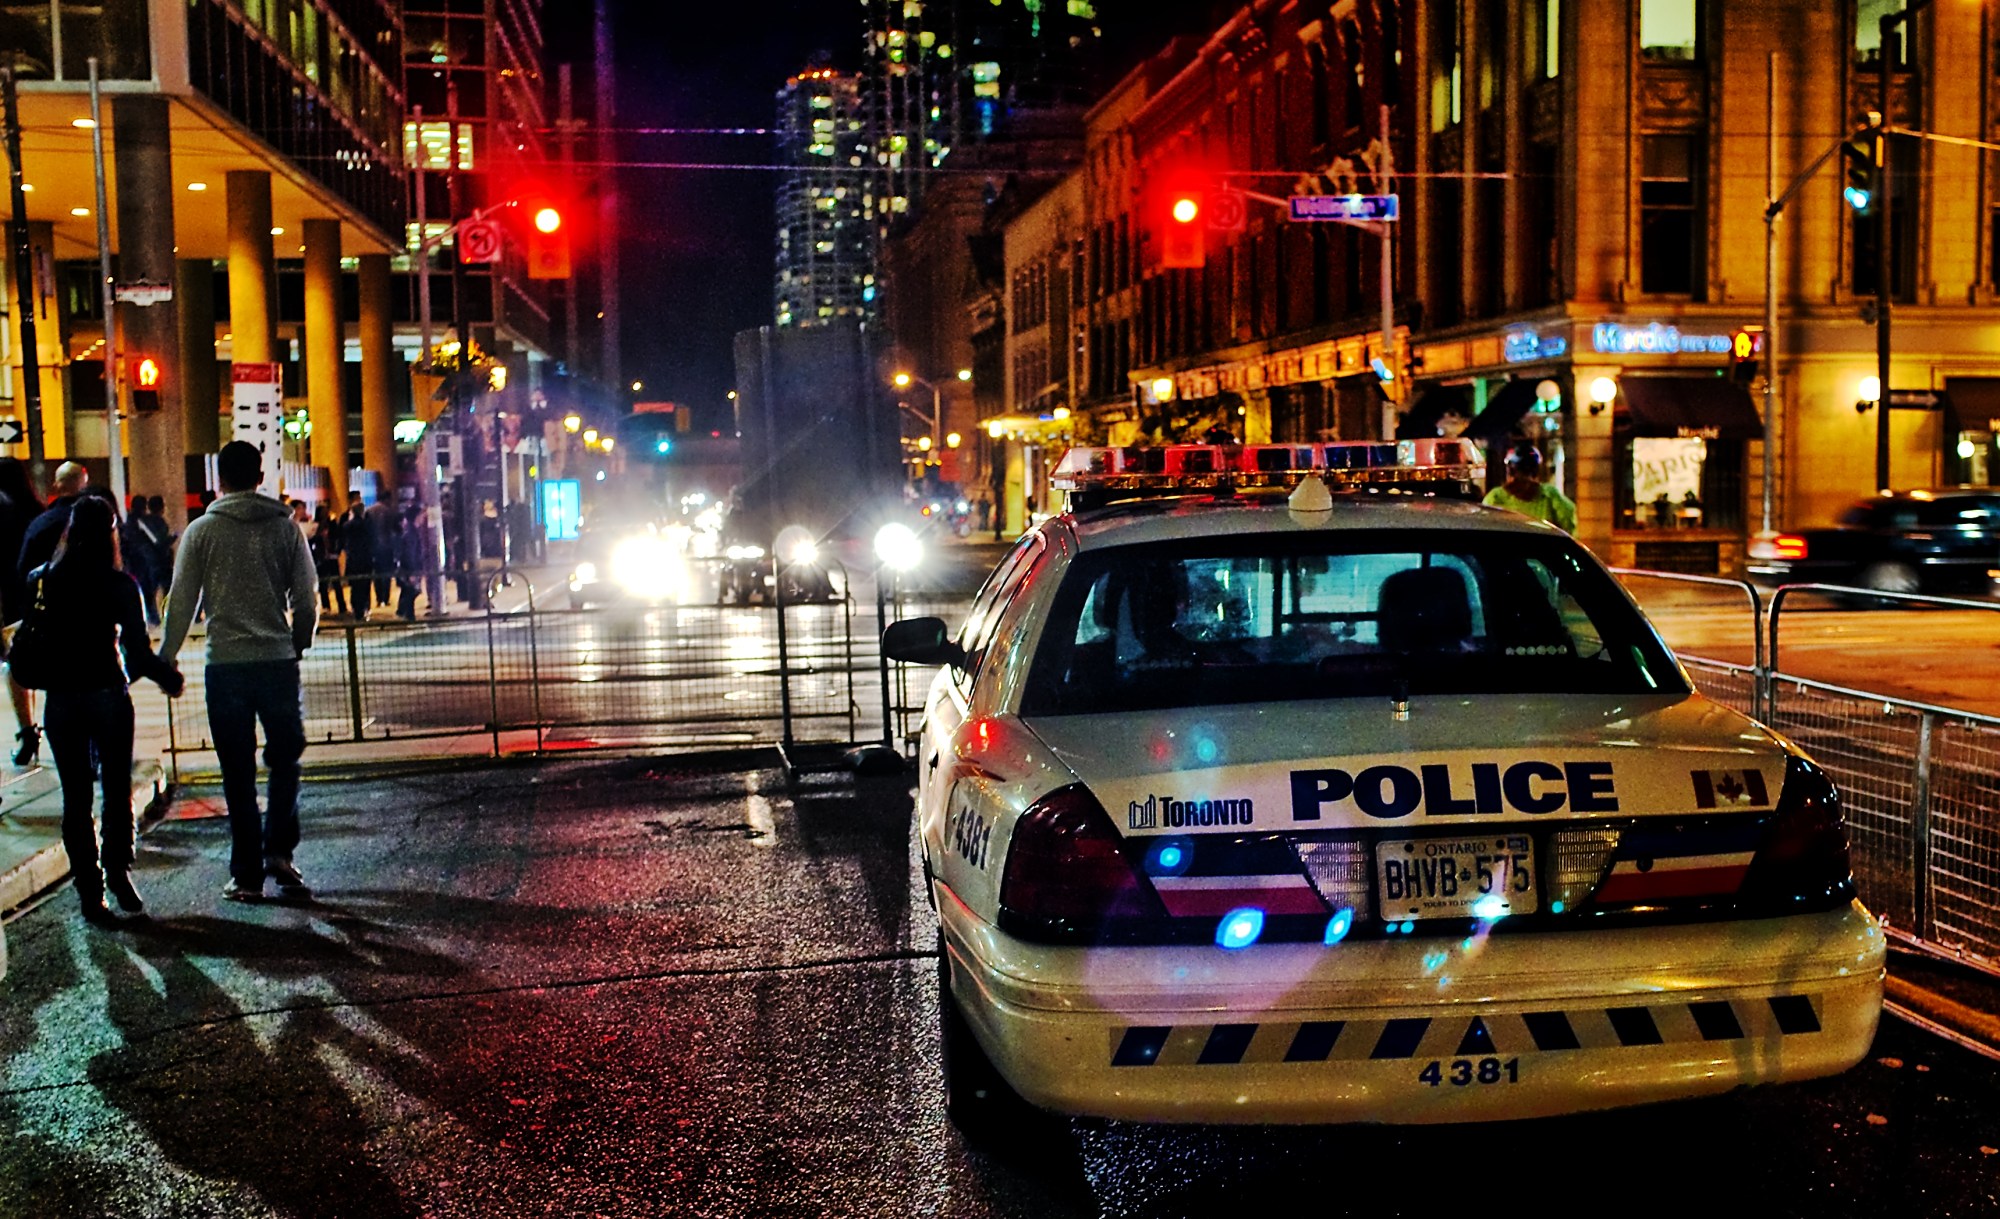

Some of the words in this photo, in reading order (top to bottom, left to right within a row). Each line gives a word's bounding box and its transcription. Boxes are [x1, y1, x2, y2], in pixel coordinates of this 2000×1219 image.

[1290, 761, 1620, 821] POLICE
[1159, 797, 1253, 828] TORONTO
[956, 805, 990, 870] 4381
[1425, 842, 1487, 857] ONTARIO
[1385, 856, 1457, 900] BHVB
[1475, 853, 1530, 894] 575
[1418, 1057, 1519, 1087] 4381
